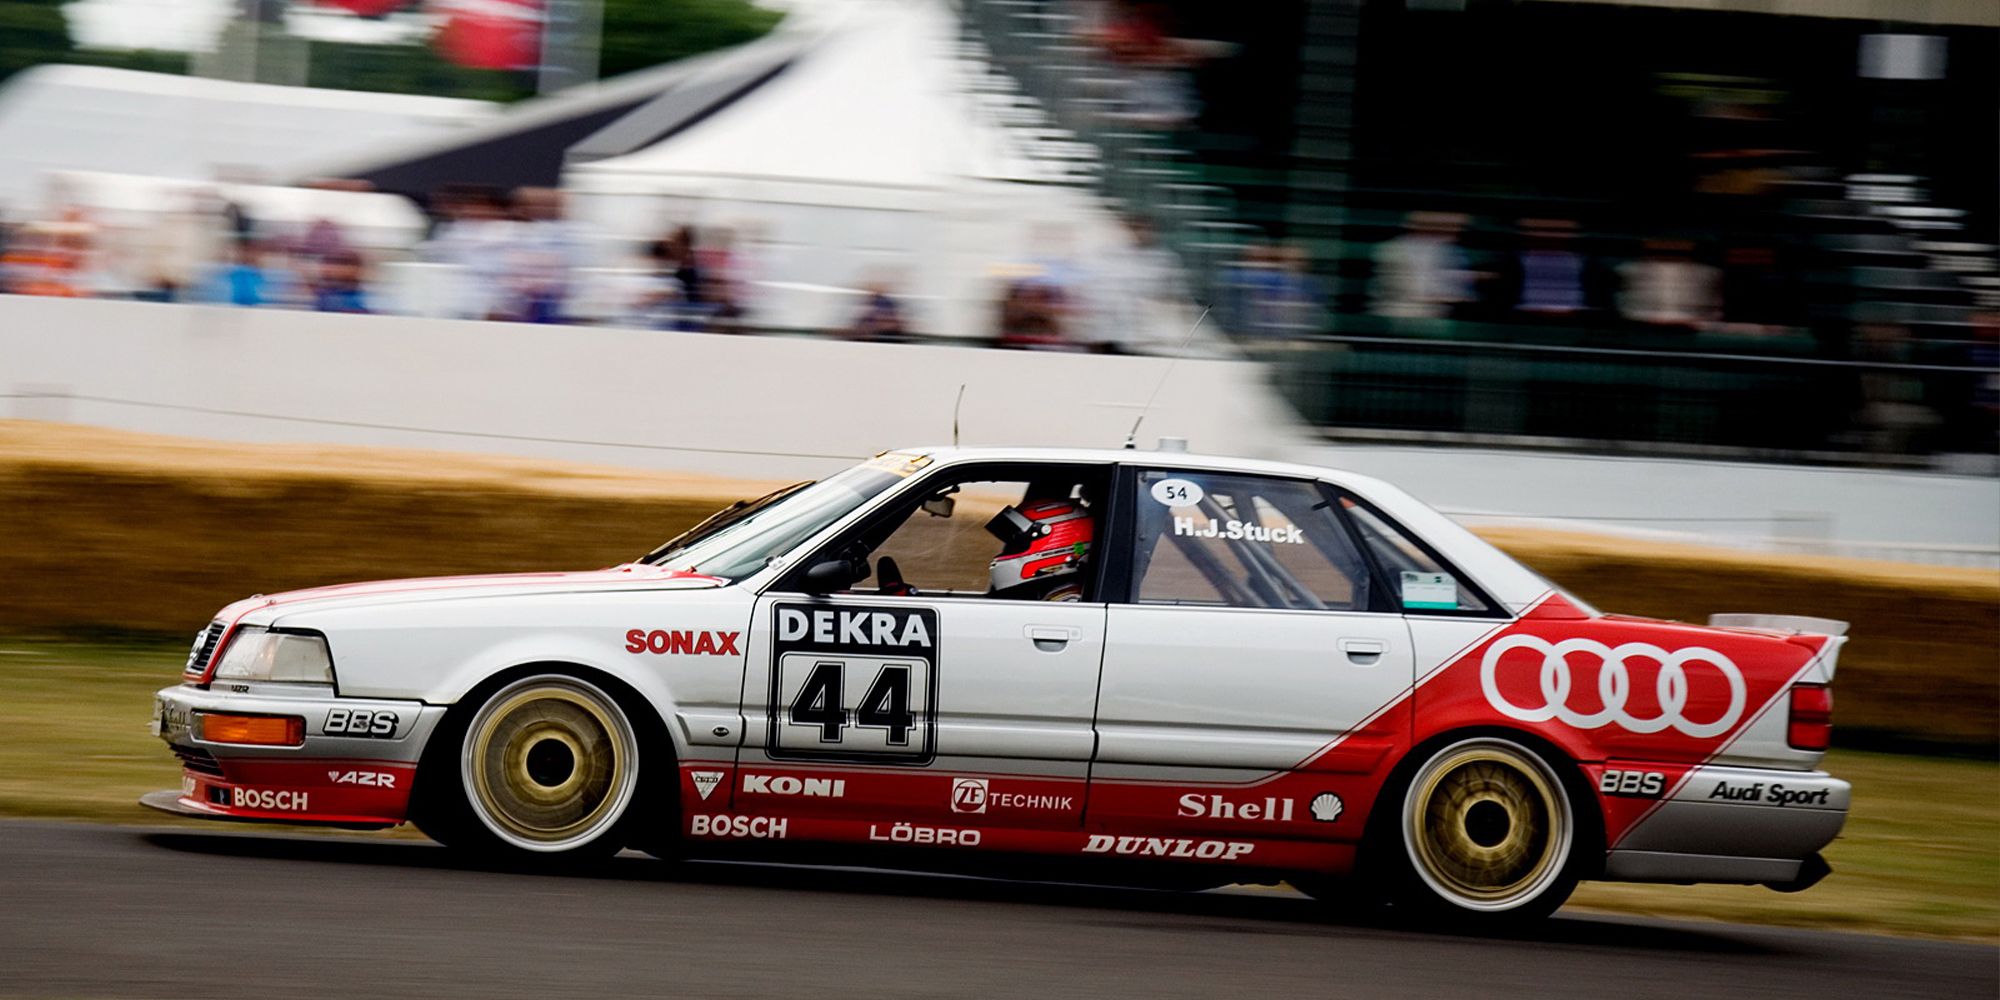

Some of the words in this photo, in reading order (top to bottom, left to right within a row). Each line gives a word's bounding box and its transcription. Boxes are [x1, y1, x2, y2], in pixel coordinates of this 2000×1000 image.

[1166, 485, 1187, 500] 54
[1173, 517, 1304, 544] H.J.Stuck
[779, 608, 931, 647] DEKRA
[625, 629, 740, 656] SONAX
[788, 660, 917, 746] 44
[323, 708, 399, 739] BBS
[337, 771, 395, 788] AZR
[743, 775, 845, 798] KONI
[1600, 769, 1664, 796] BBS
[234, 787, 309, 811] BOSCH
[989, 792, 1073, 810] TECHNIK
[1709, 781, 1763, 801] Audi
[1766, 784, 1829, 807] Sport
[1177, 793, 1294, 822] Shell
[691, 814, 788, 839] BOSCH
[869, 822, 981, 846] LÖBRO
[1081, 834, 1255, 860] DUNLOP
